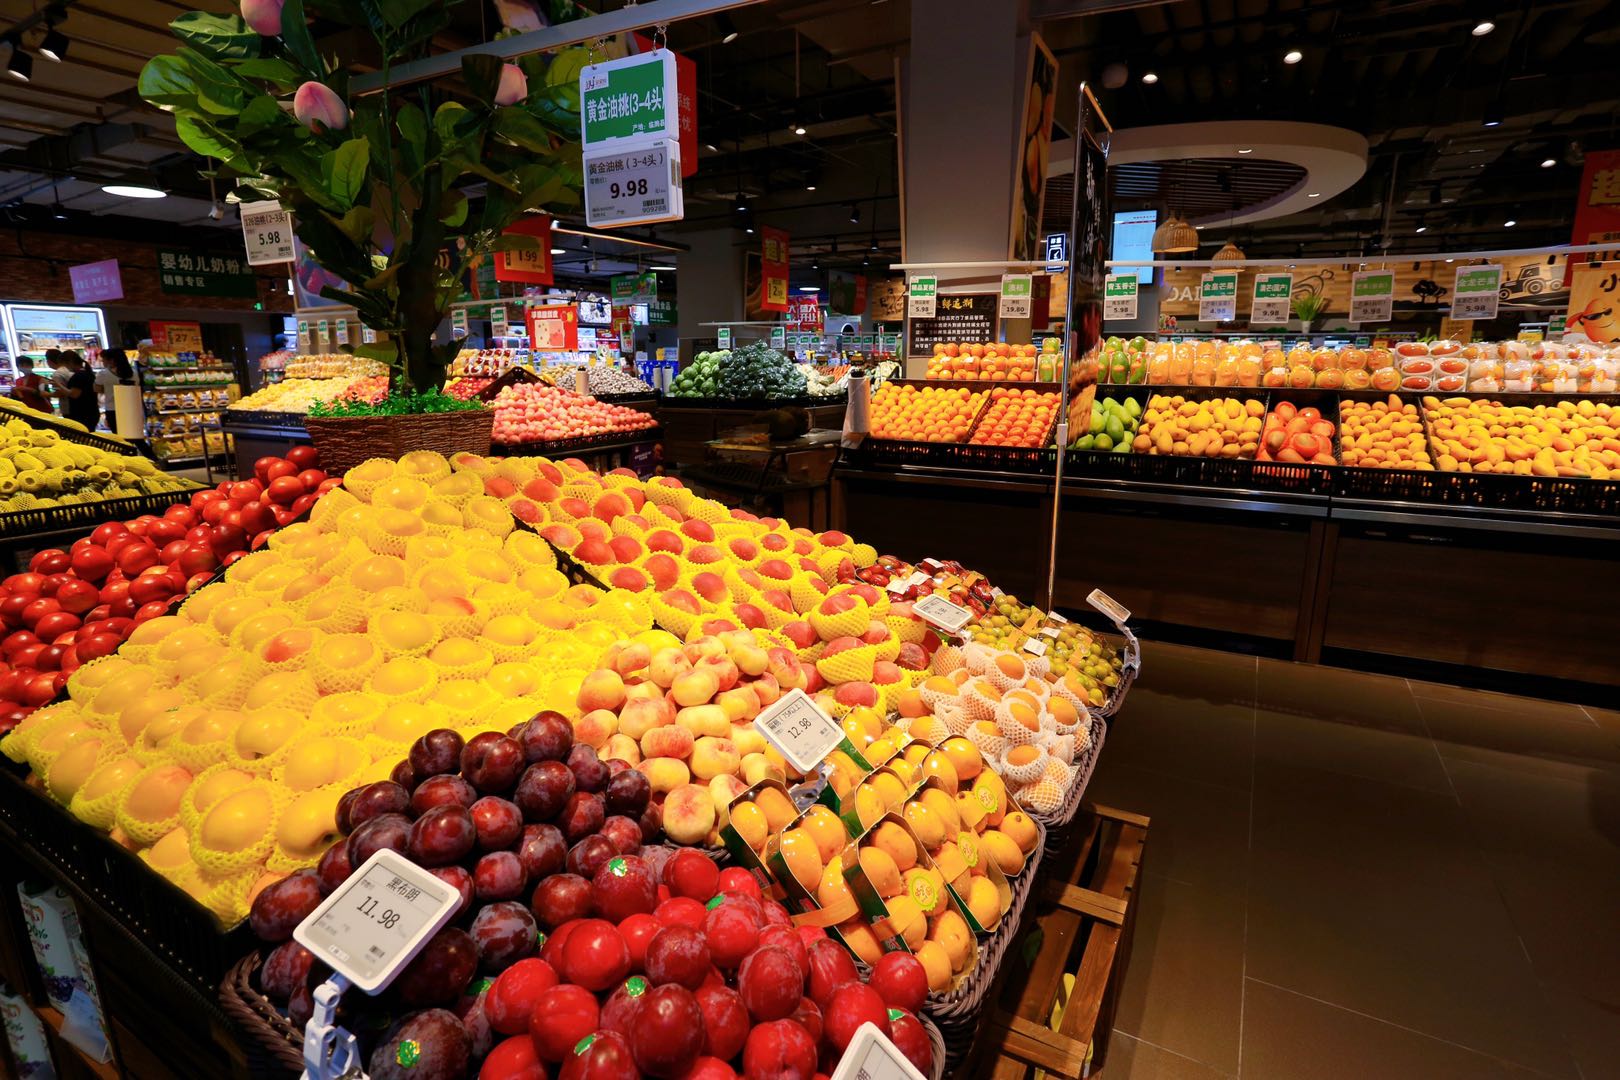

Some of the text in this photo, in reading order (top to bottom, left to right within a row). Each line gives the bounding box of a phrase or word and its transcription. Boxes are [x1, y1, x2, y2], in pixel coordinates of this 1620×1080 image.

[587, 86, 665, 123] 黄金油桃(3-4头)
[610, 179, 648, 199] 9.98
[259, 231, 280, 245] 5.98
[1465, 304, 1486, 312] 5.98
[787, 717, 812, 739] 12.98
[386, 876, 421, 902] 黑布朗
[356, 896, 401, 929] 11.98
